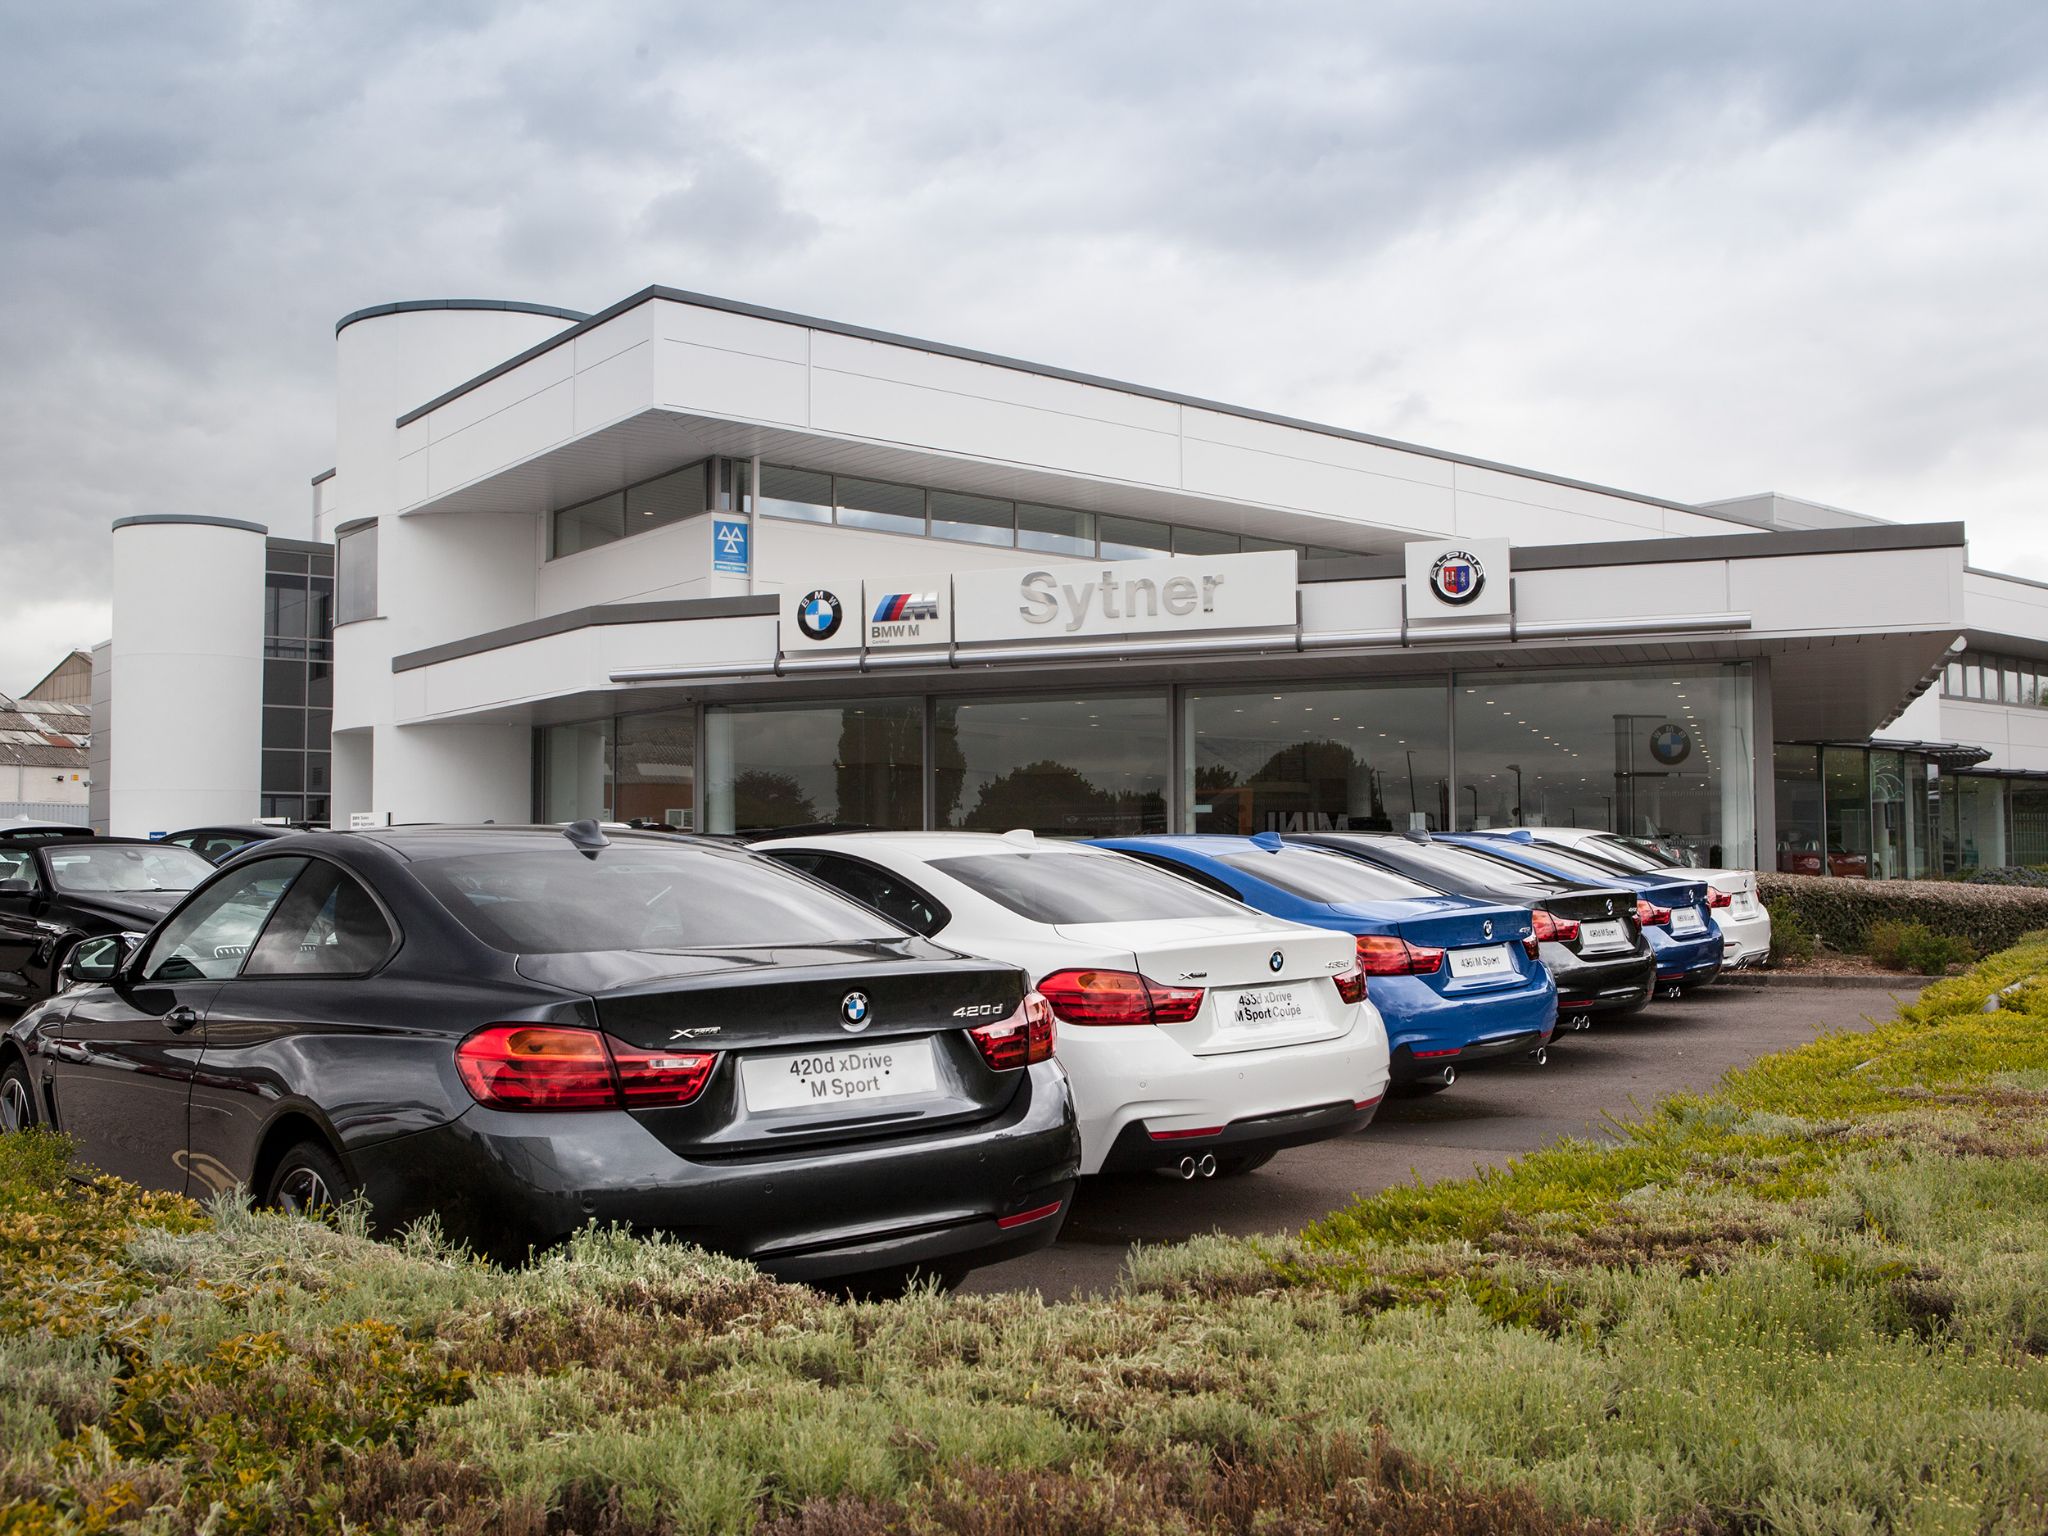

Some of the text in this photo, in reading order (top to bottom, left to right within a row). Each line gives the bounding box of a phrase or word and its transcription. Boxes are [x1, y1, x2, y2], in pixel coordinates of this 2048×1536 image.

[1430, 551, 1483, 580] ALPINA
[801, 591, 839, 608] BMW
[1019, 570, 1224, 632] Sytner
[871, 624, 920, 638] BMW M
[1482, 956, 1500, 967] Sport
[1264, 991, 1292, 1004] xDrive
[953, 1003, 1003, 1018] 420d
[1234, 1004, 1302, 1022] M Sport Coupé
[790, 1053, 893, 1076] 420d xDrive
[811, 1076, 880, 1098] M Sport
